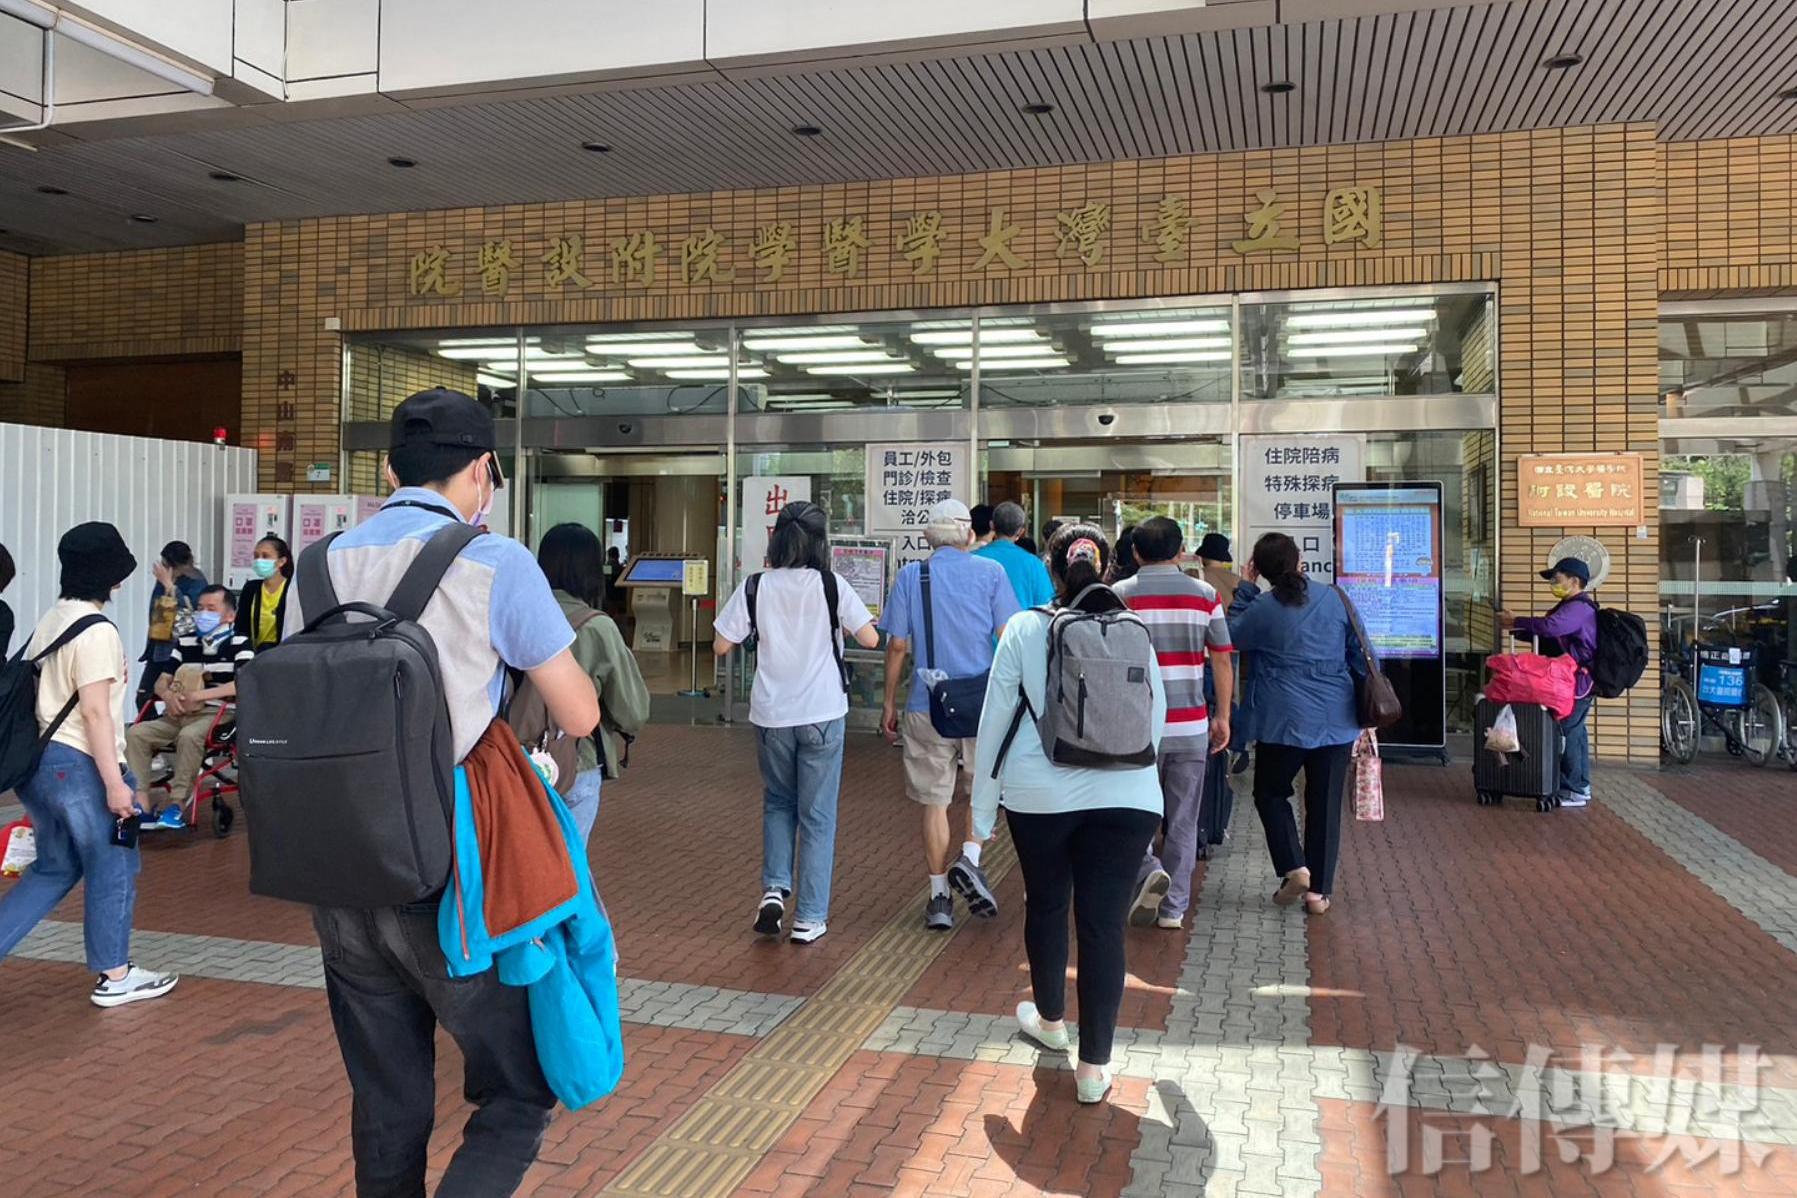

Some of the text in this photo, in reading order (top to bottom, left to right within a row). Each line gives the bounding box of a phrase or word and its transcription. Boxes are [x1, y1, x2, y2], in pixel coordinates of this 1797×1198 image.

[883, 451, 952, 468] 員工/外包
[1264, 447, 1340, 464] 住院陪病
[883, 470, 952, 487] 門診/檢查
[901, 509, 930, 525] 洽公
[1274, 502, 1330, 520] 停車場
[1718, 675, 1743, 686] 136
